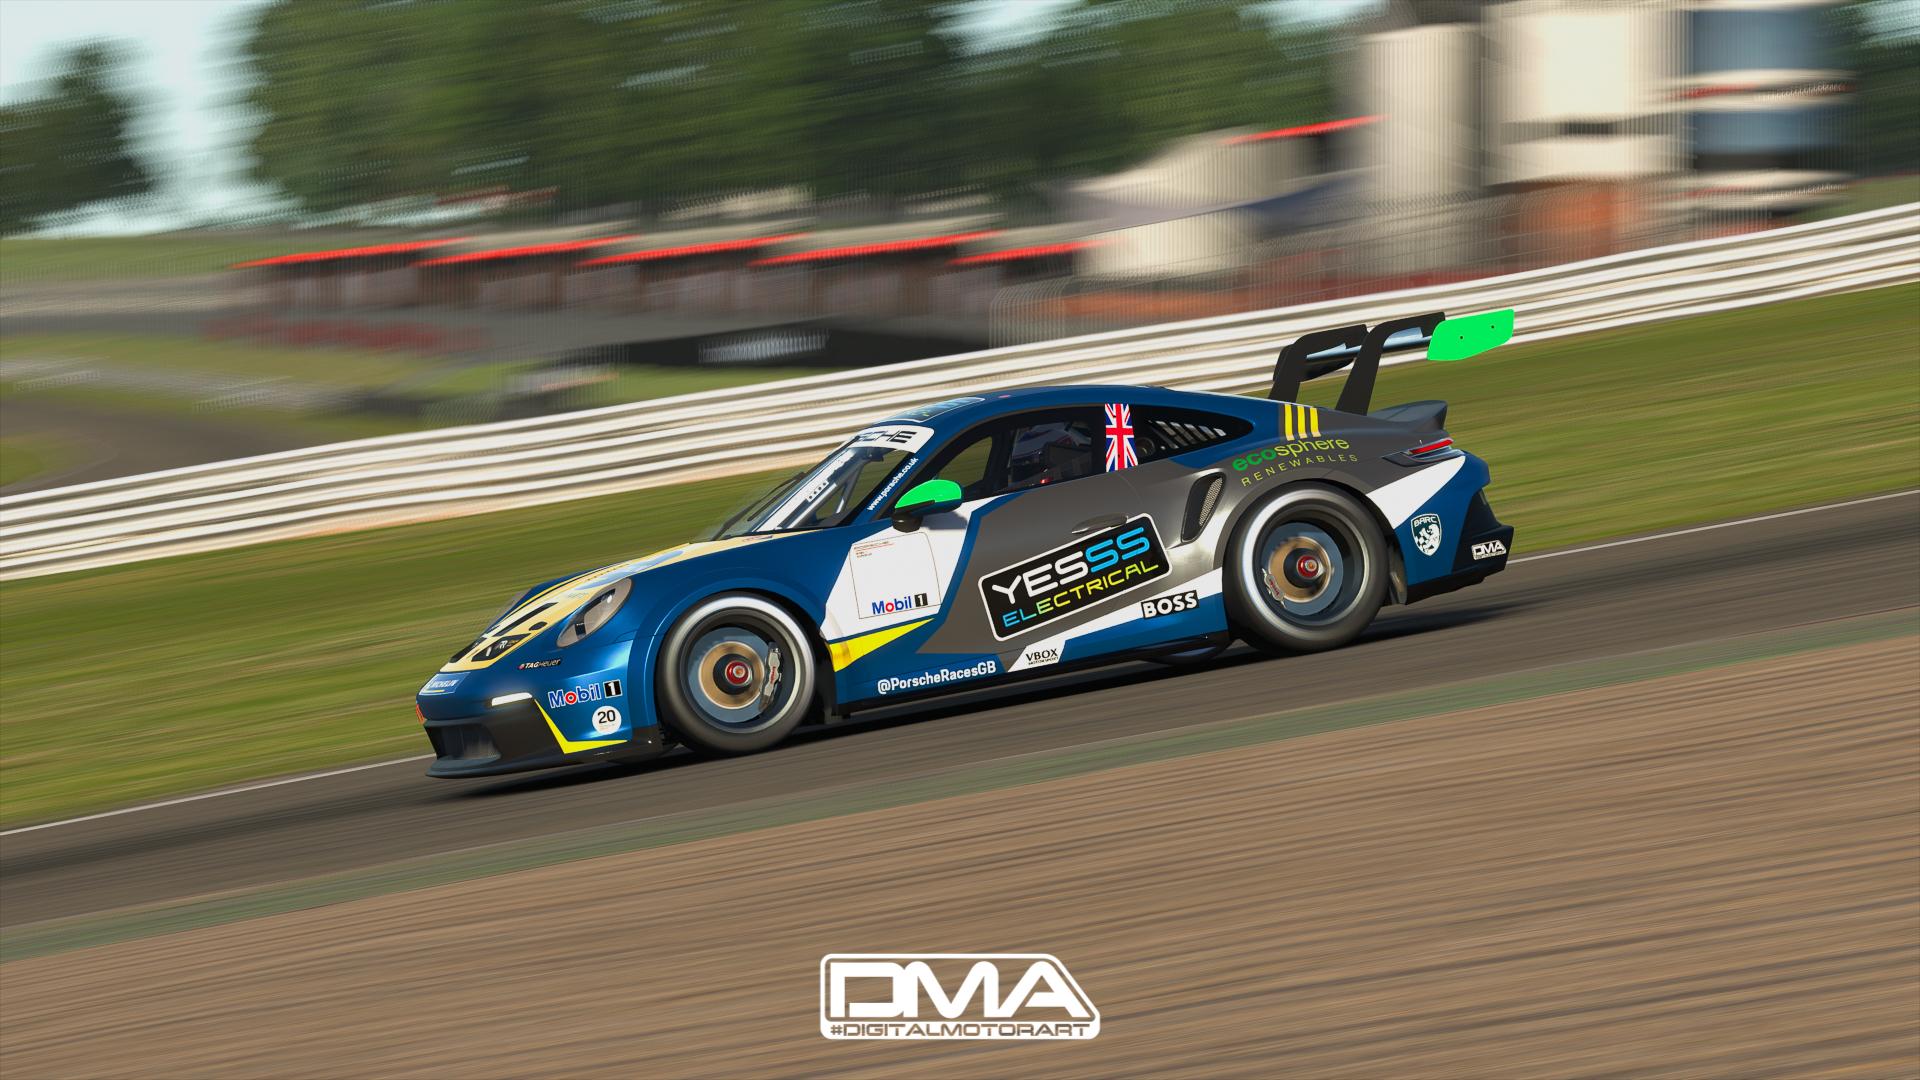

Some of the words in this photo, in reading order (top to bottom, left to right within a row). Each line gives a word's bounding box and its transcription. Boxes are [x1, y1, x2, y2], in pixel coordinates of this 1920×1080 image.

[1232, 439, 1350, 472] ecosphere
[867, 457, 919, 511] www.porsche.co.uk
[1241, 454, 1358, 487] RENEWABLES
[1413, 516, 1438, 528] BARC
[1472, 541, 1505, 556] DMA
[992, 526, 1151, 604] YESSS
[871, 596, 912, 615] Mobil
[1002, 561, 1159, 628] ELECTRICAL
[1142, 591, 1198, 618] BOSS
[1025, 648, 1059, 662] VBOX
[877, 660, 997, 695] @PorscheRacesGB
[547, 683, 602, 709] Mobil
[597, 709, 616, 724] 20
